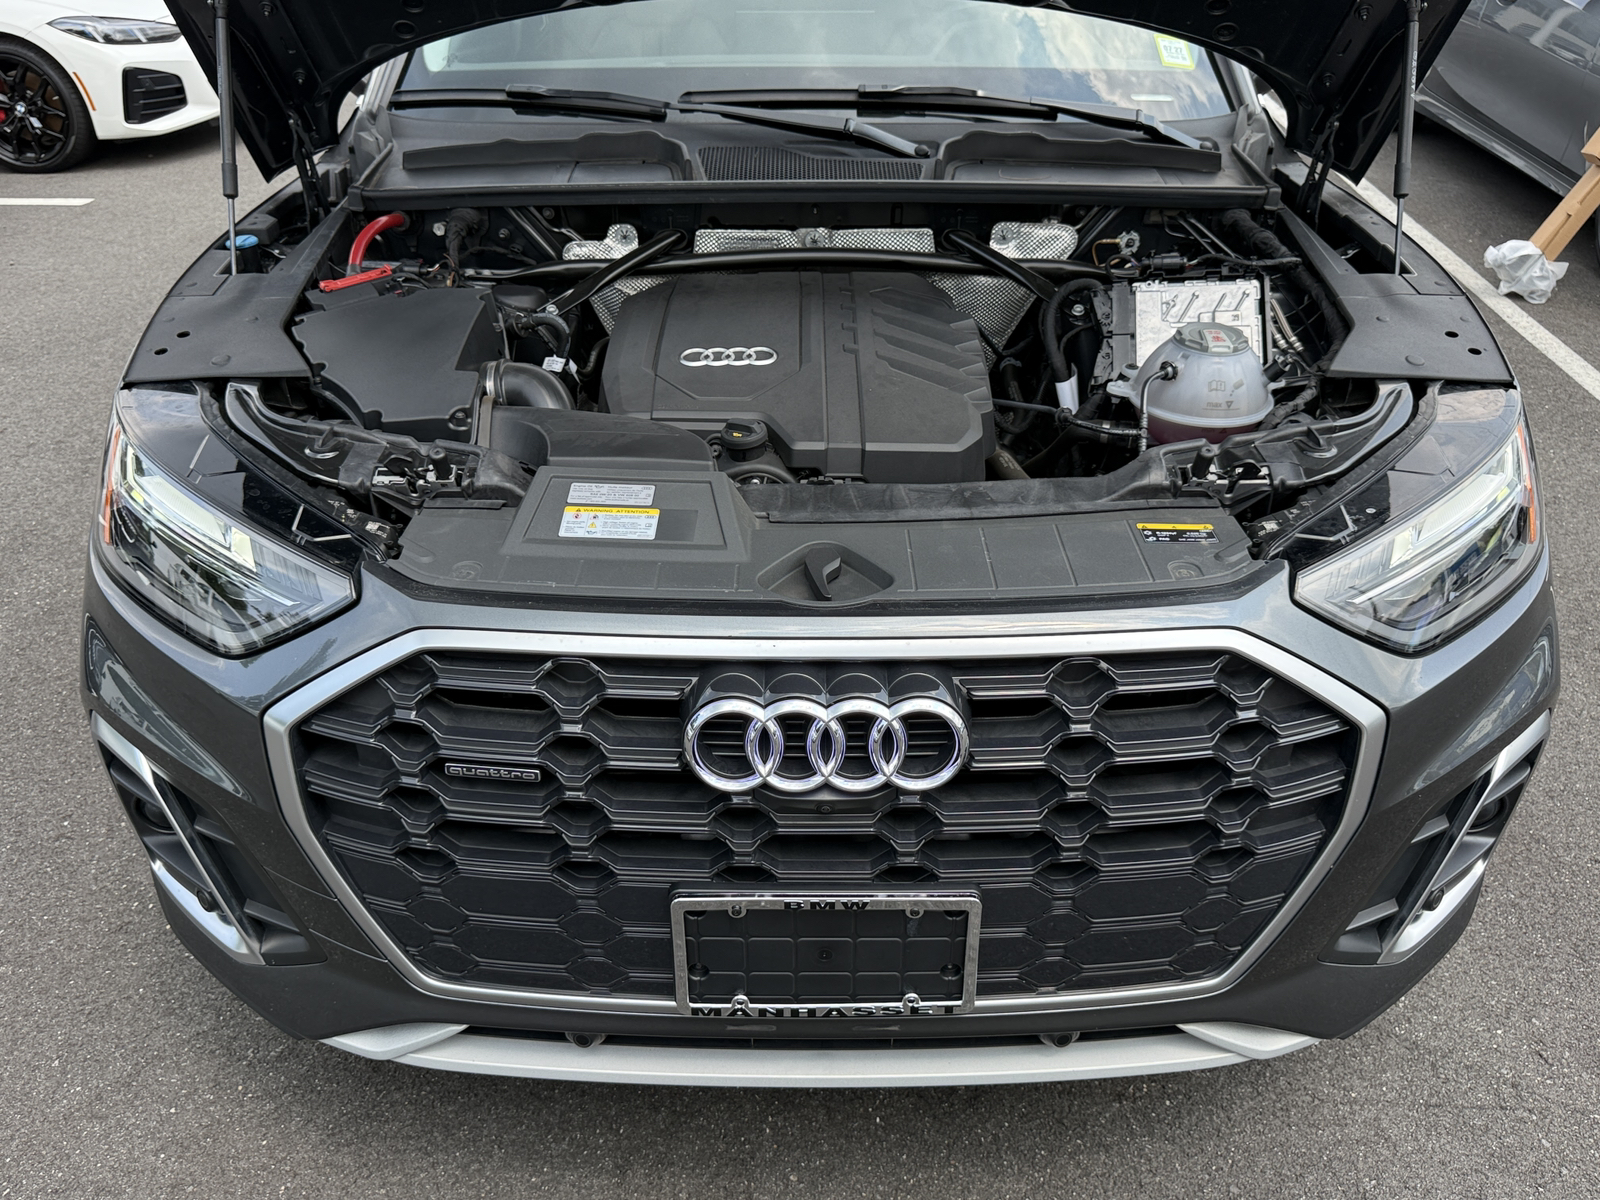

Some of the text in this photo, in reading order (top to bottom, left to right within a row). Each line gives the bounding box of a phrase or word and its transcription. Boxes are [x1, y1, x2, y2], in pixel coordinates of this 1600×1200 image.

[449, 767, 536, 780] quattro
[783, 899, 871, 910] BMW
[690, 1005, 957, 1018] MANHASSET
